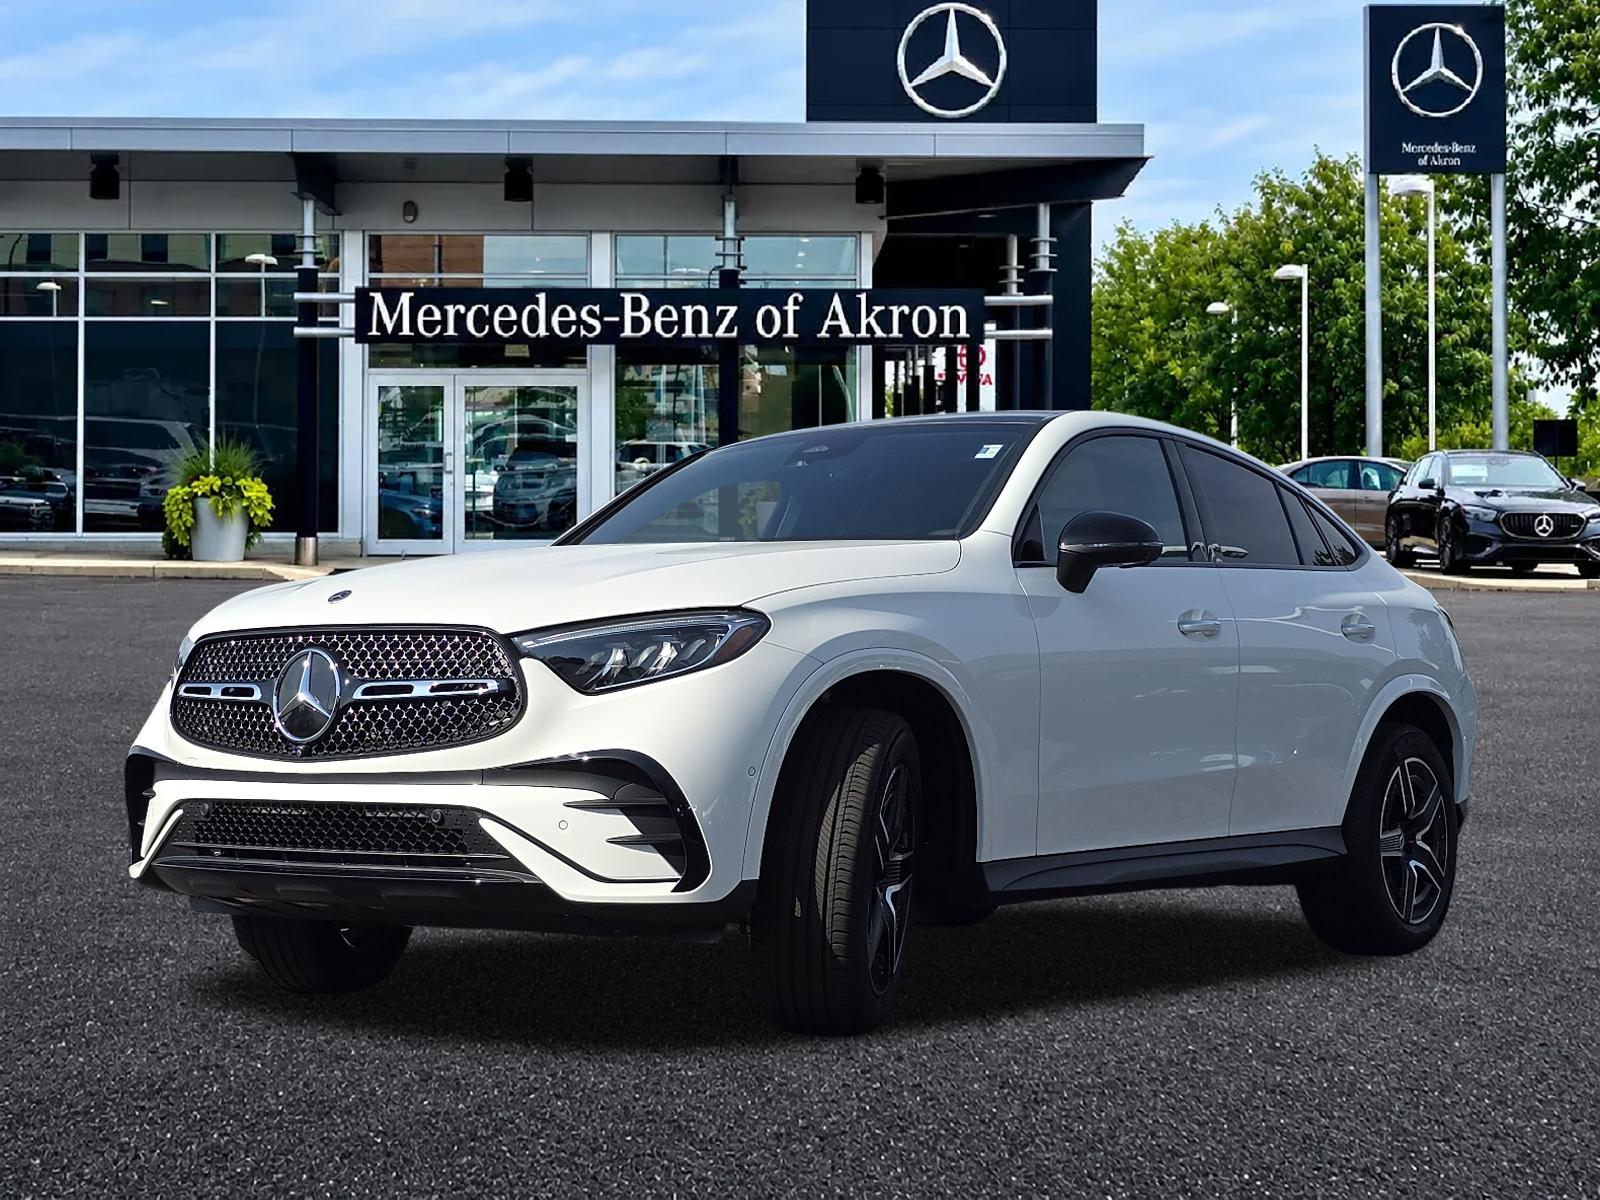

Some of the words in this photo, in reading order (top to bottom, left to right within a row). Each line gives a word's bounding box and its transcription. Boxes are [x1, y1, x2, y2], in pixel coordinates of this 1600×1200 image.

[1401, 142, 1476, 154] Mercedes-Benz
[1417, 154, 1428, 166] of
[1430, 154, 1461, 166] Akron
[367, 292, 738, 338] Mercedes-Benz
[755, 292, 803, 338] of
[816, 292, 971, 338] Akron
